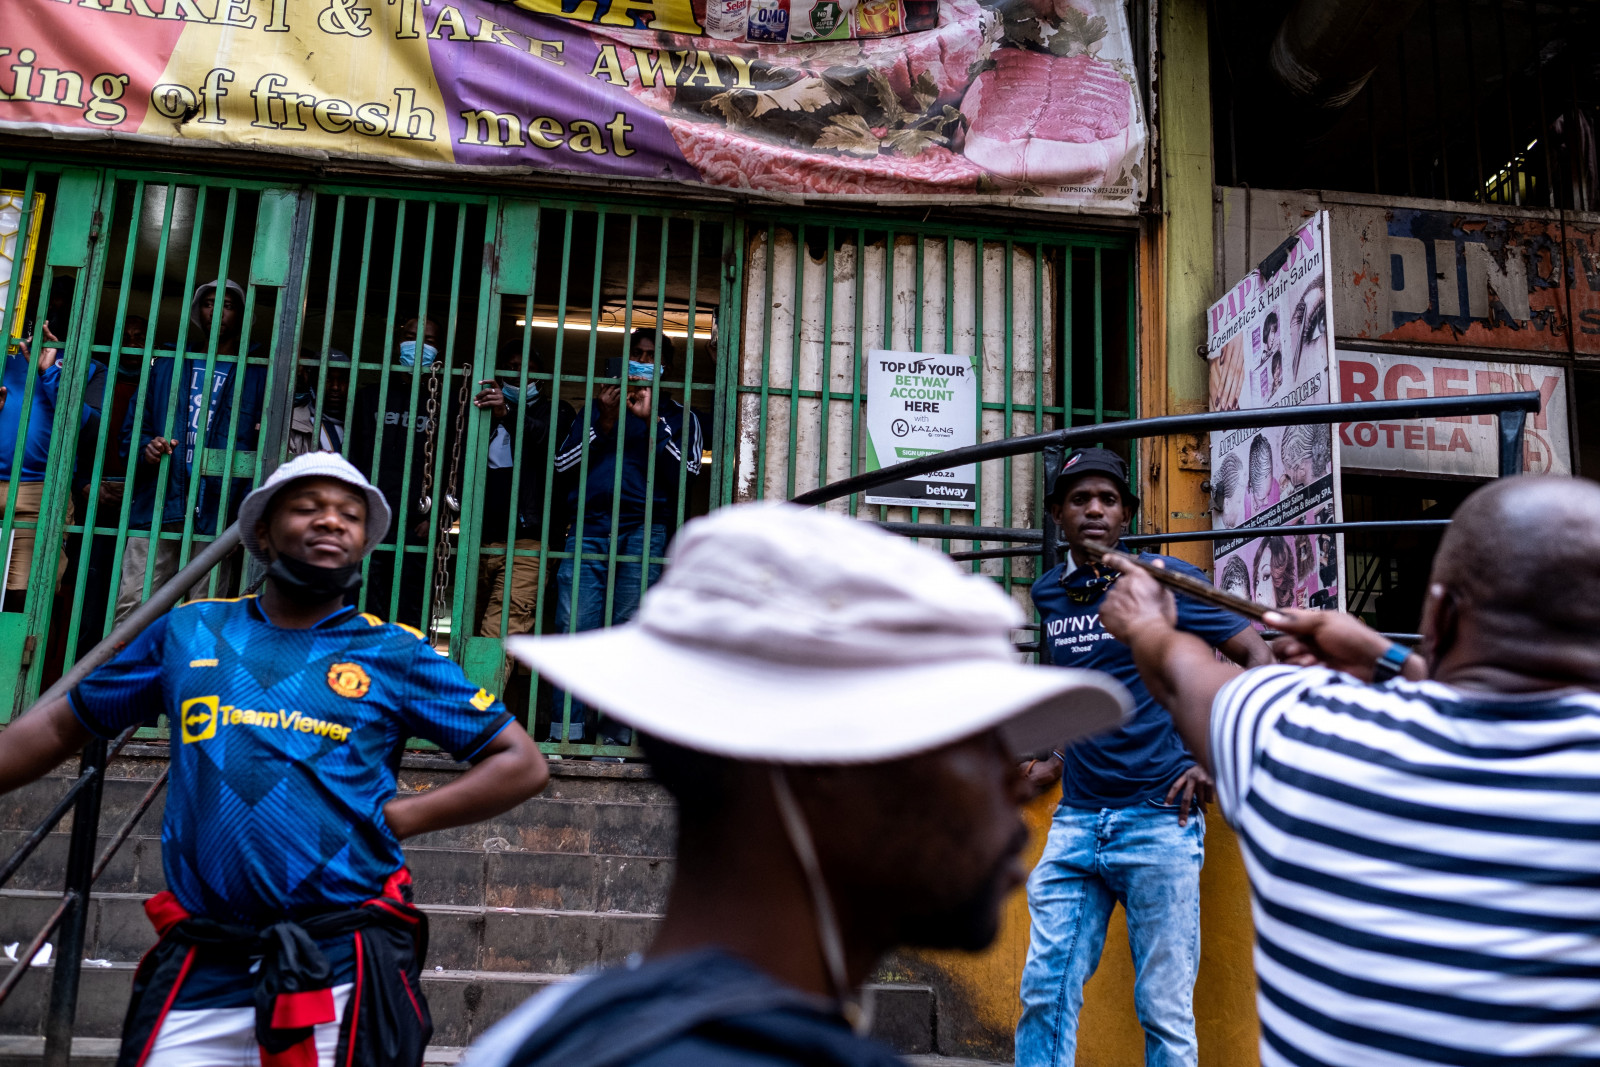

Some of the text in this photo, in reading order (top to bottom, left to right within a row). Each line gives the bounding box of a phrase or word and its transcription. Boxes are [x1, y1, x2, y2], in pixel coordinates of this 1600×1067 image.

[758, 8, 787, 24] OMO
[317, 0, 373, 38] &
[389, 0, 565, 66] TAKE
[586, 43, 756, 90] AWAY
[0, 48, 636, 158] ing of fresh meat
[1210, 308, 1256, 353] Cosmetics
[1258, 295, 1266, 313] &
[1267, 279, 1288, 306] Hair
[1290, 252, 1320, 286] Salon
[880, 361, 964, 376] TOP UP YOUR
[895, 375, 950, 388] BETWAY
[890, 387, 954, 401] ACCOUNT
[904, 401, 939, 413] HERE
[911, 422, 954, 435] KAZANG
[926, 485, 968, 498] betway
[1305, 494, 1321, 507] Beauty
[1256, 509, 1276, 524] Cosmetics
[1282, 500, 1291, 510] Hair
[1291, 493, 1304, 505] Salon
[1054, 636, 1077, 646] Please
[1079, 634, 1099, 643] bribe
[220, 705, 352, 742] TeamViewer
